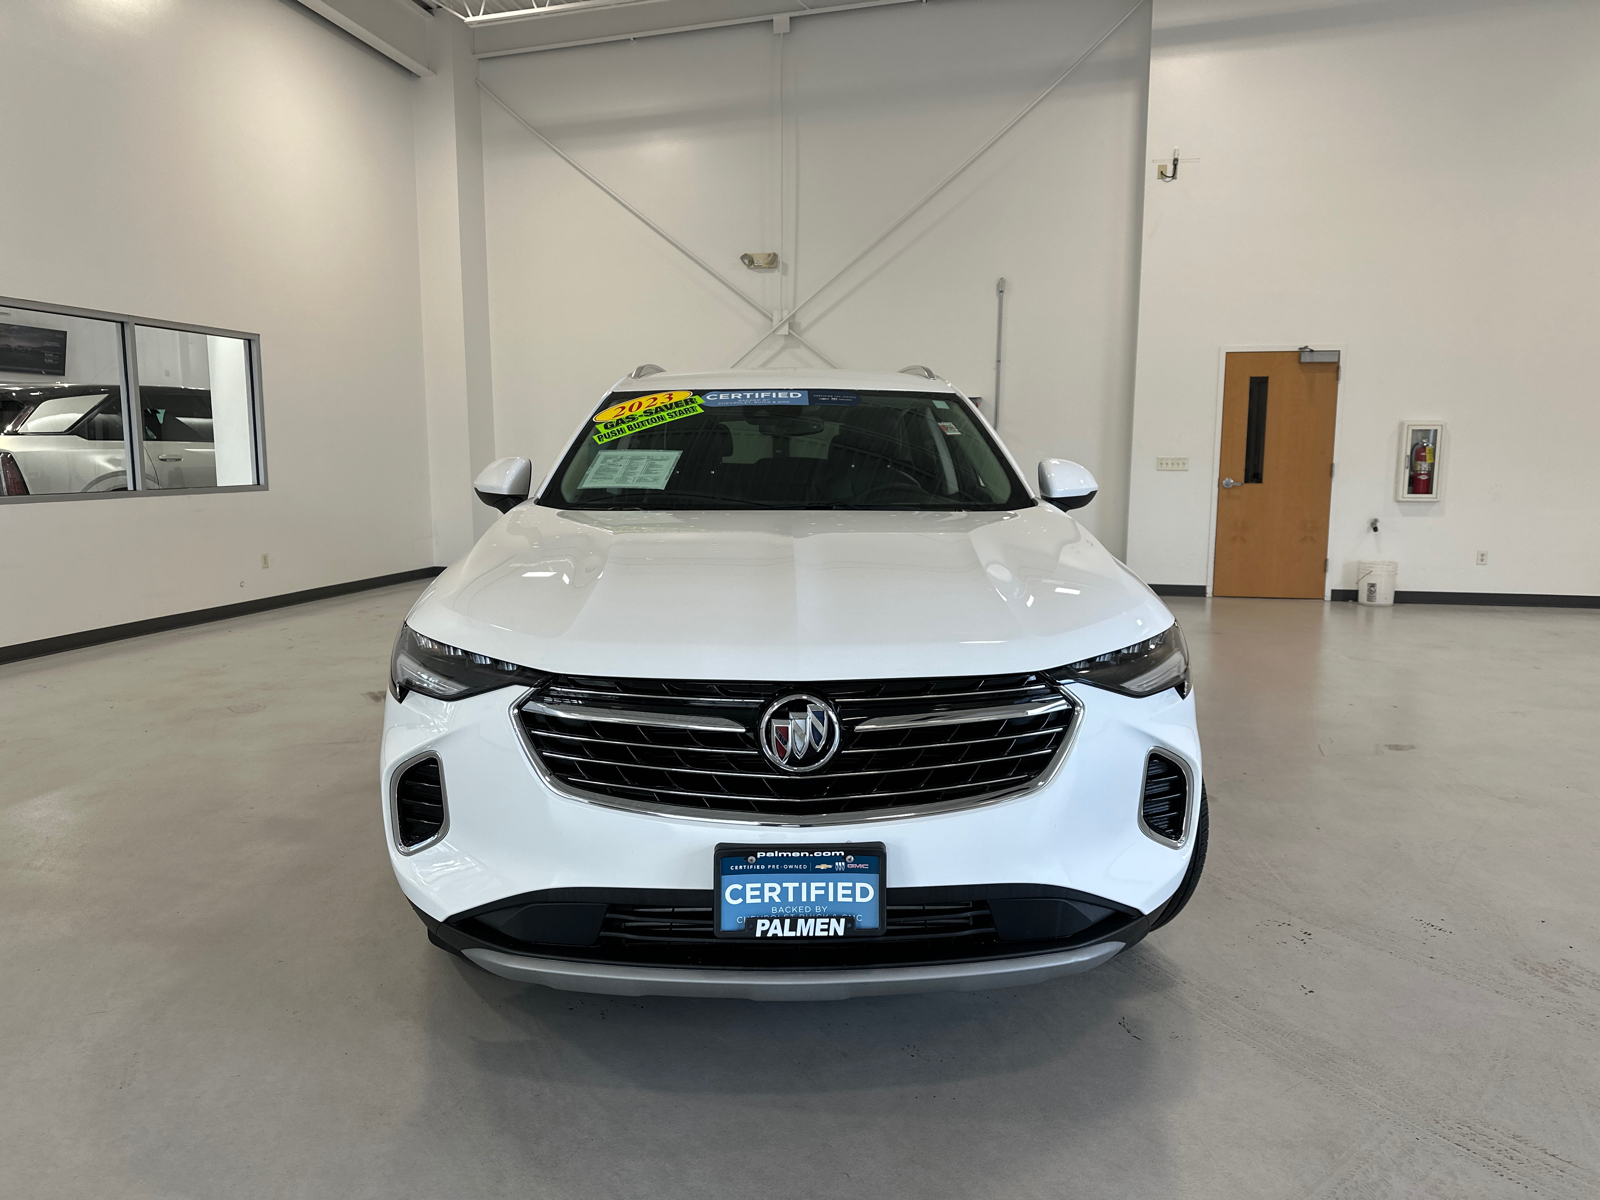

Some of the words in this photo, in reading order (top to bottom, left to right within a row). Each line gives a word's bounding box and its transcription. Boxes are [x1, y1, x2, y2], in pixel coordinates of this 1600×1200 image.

[612, 393, 673, 419] 2023
[706, 392, 802, 400] CERTIFIED
[597, 426, 627, 442] PUSH
[627, 414, 666, 431] BUTTON
[667, 405, 698, 419] START
[603, 398, 698, 430] GAS-SAVER
[756, 850, 845, 858] palmen.com
[724, 882, 875, 905] CERTIFIED
[771, 906, 812, 914] BACKED
[755, 918, 846, 937] PALMEN
